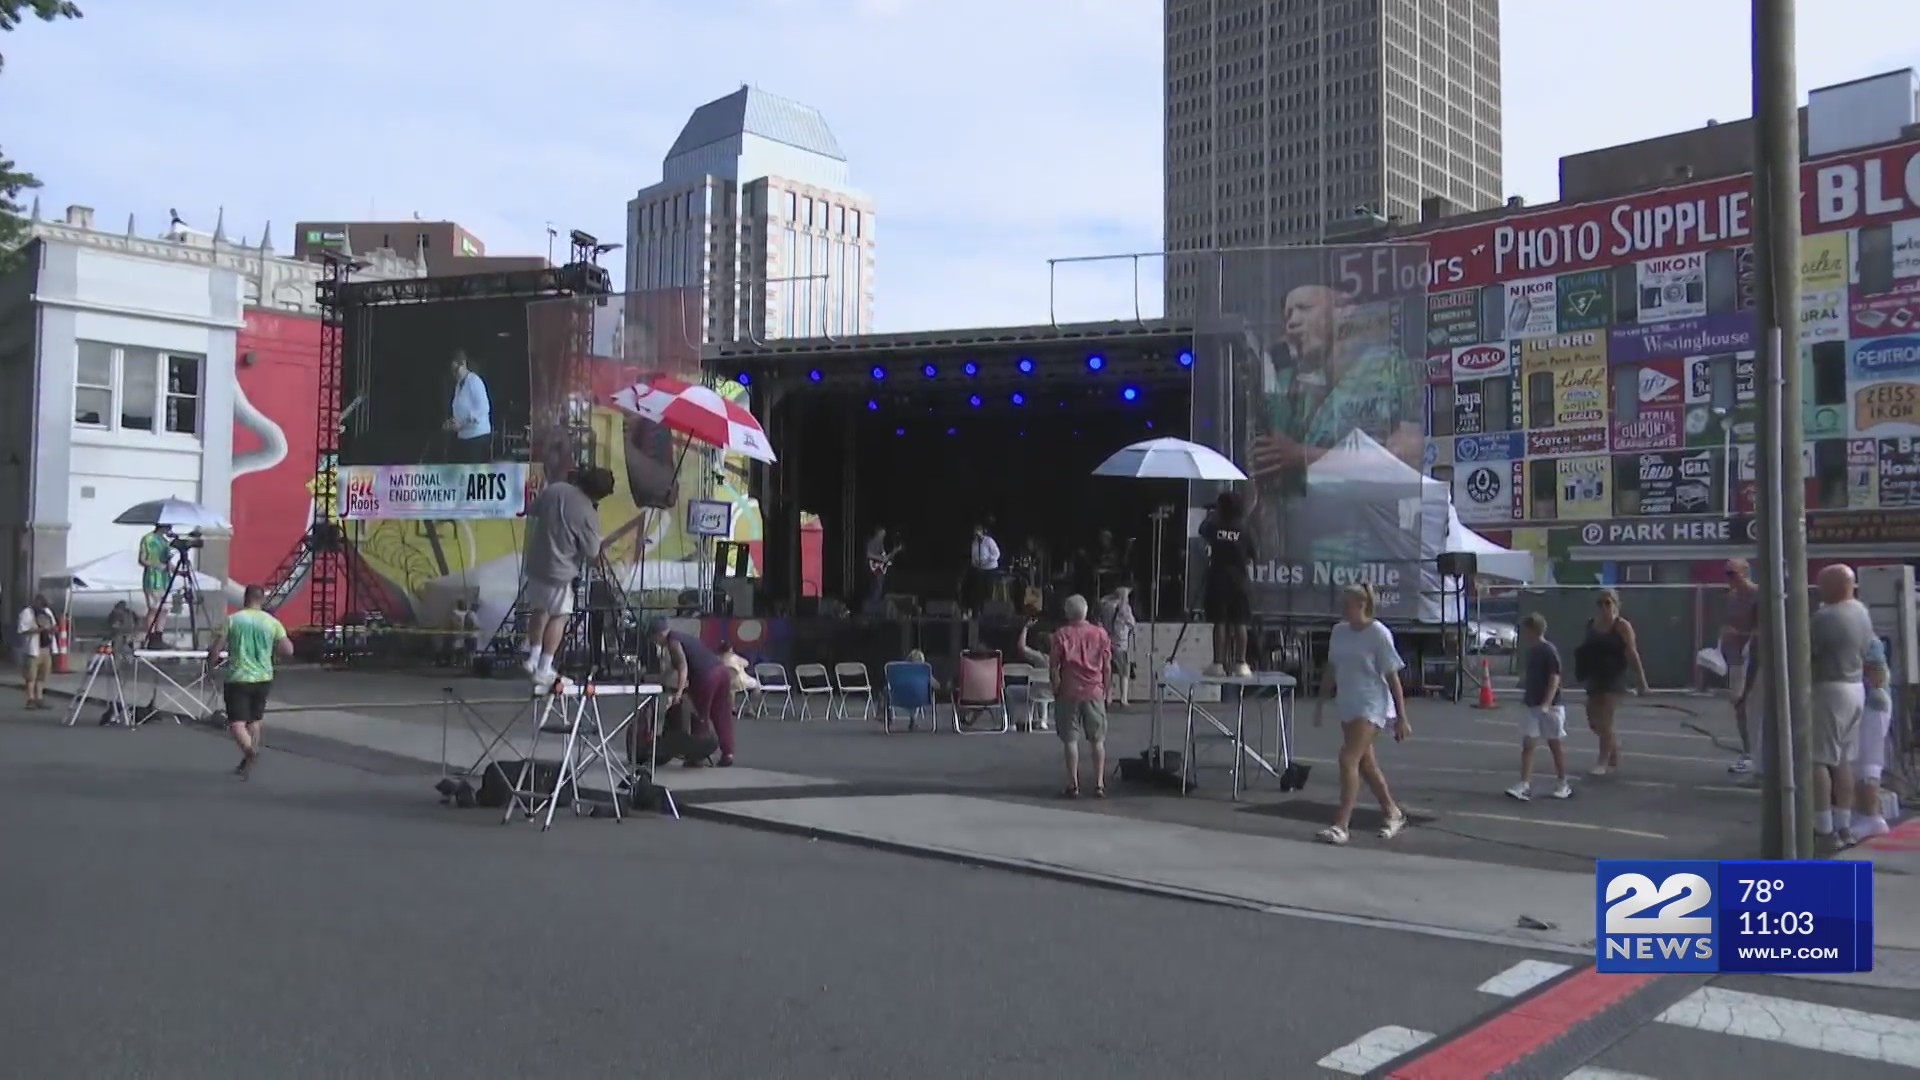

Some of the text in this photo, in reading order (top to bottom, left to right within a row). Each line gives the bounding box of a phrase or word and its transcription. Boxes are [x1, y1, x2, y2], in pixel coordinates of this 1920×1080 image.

[1340, 252, 1363, 299] 5
[1371, 247, 1465, 294] Floors
[1494, 220, 1600, 274] PHOTO
[1610, 190, 1750, 256] SUPPLIE
[1645, 255, 1701, 275] NIKON
[1510, 281, 1554, 297] NIKOR
[1800, 308, 1839, 323] URAL
[1529, 332, 1595, 352] ILFORD
[1643, 330, 1750, 353] Westinghouse
[1462, 350, 1501, 367] PAKO
[1866, 385, 1916, 404] ZEISS
[1871, 404, 1914, 419] IKON
[1622, 421, 1666, 438] DUPONT
[1532, 436, 1571, 447] SCOTCH
[389, 473, 440, 487] NATIONAL
[466, 472, 507, 501] ARTS
[350, 493, 380, 512] Roots
[389, 488, 457, 503] ENDOWMENT
[1609, 522, 1666, 542] PARK
[1672, 521, 1730, 540] HERE
[1312, 560, 1400, 586] Neville
